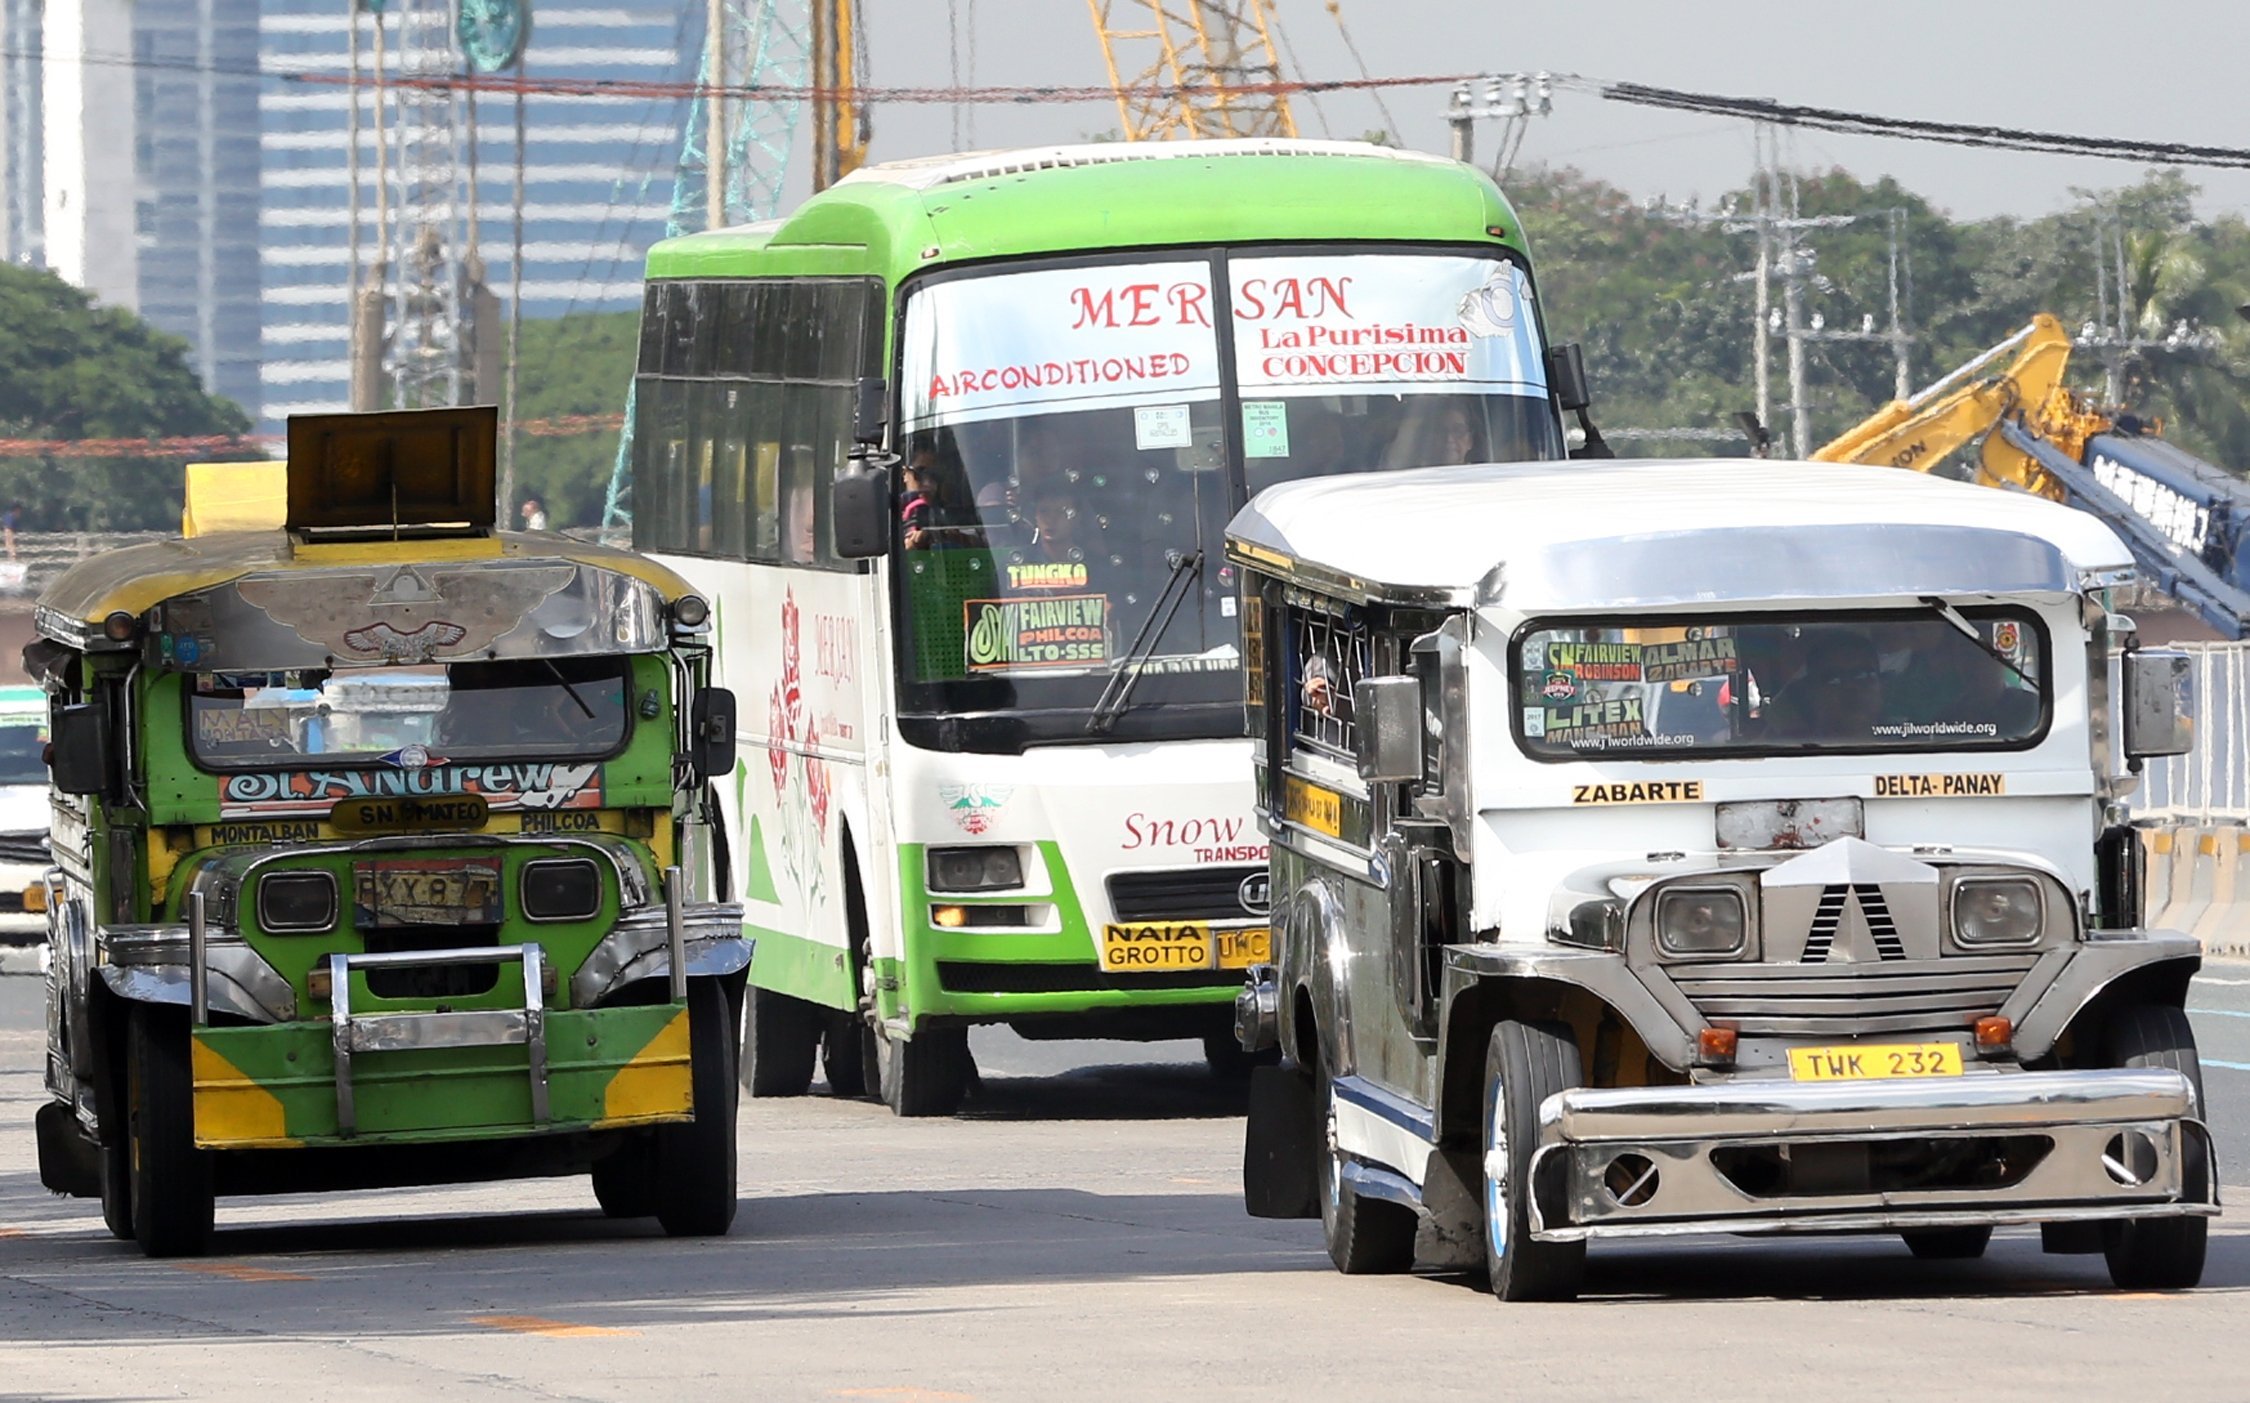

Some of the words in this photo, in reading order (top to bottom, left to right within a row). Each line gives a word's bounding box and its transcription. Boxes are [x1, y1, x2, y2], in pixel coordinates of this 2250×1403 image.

[1071, 283, 1212, 330] MER
[1234, 276, 1355, 320] SAN
[928, 353, 1190, 399] AIRCONDITIONED
[1262, 352, 1467, 377] CONCEPCION
[1008, 563, 1088, 588] TUNGKO
[1020, 599, 1103, 631] FAIRVIEW
[1019, 627, 1103, 645] PHILCOA
[1576, 644, 1641, 663] FAIRVIEW
[1645, 638, 1737, 667] ALMAR
[1575, 663, 1641, 681] ROBINSON
[1647, 658, 1738, 682] ZABARTE
[1546, 699, 1642, 731] LITEX
[1872, 721, 1997, 738] www.jilworldwide.org
[1574, 782, 1700, 803] ZABARTE
[1943, 774, 2003, 795] PANAY
[417, 803, 481, 822] MATEO
[521, 813, 600, 833] PHILCOA
[211, 822, 319, 845] MONTALBAN
[1122, 812, 1244, 850] Snow
[1108, 926, 1202, 943] NAIA
[1109, 946, 1204, 965] GROTTO
[1808, 1055, 1863, 1077] TWK
[1888, 1052, 1946, 1075] 232
